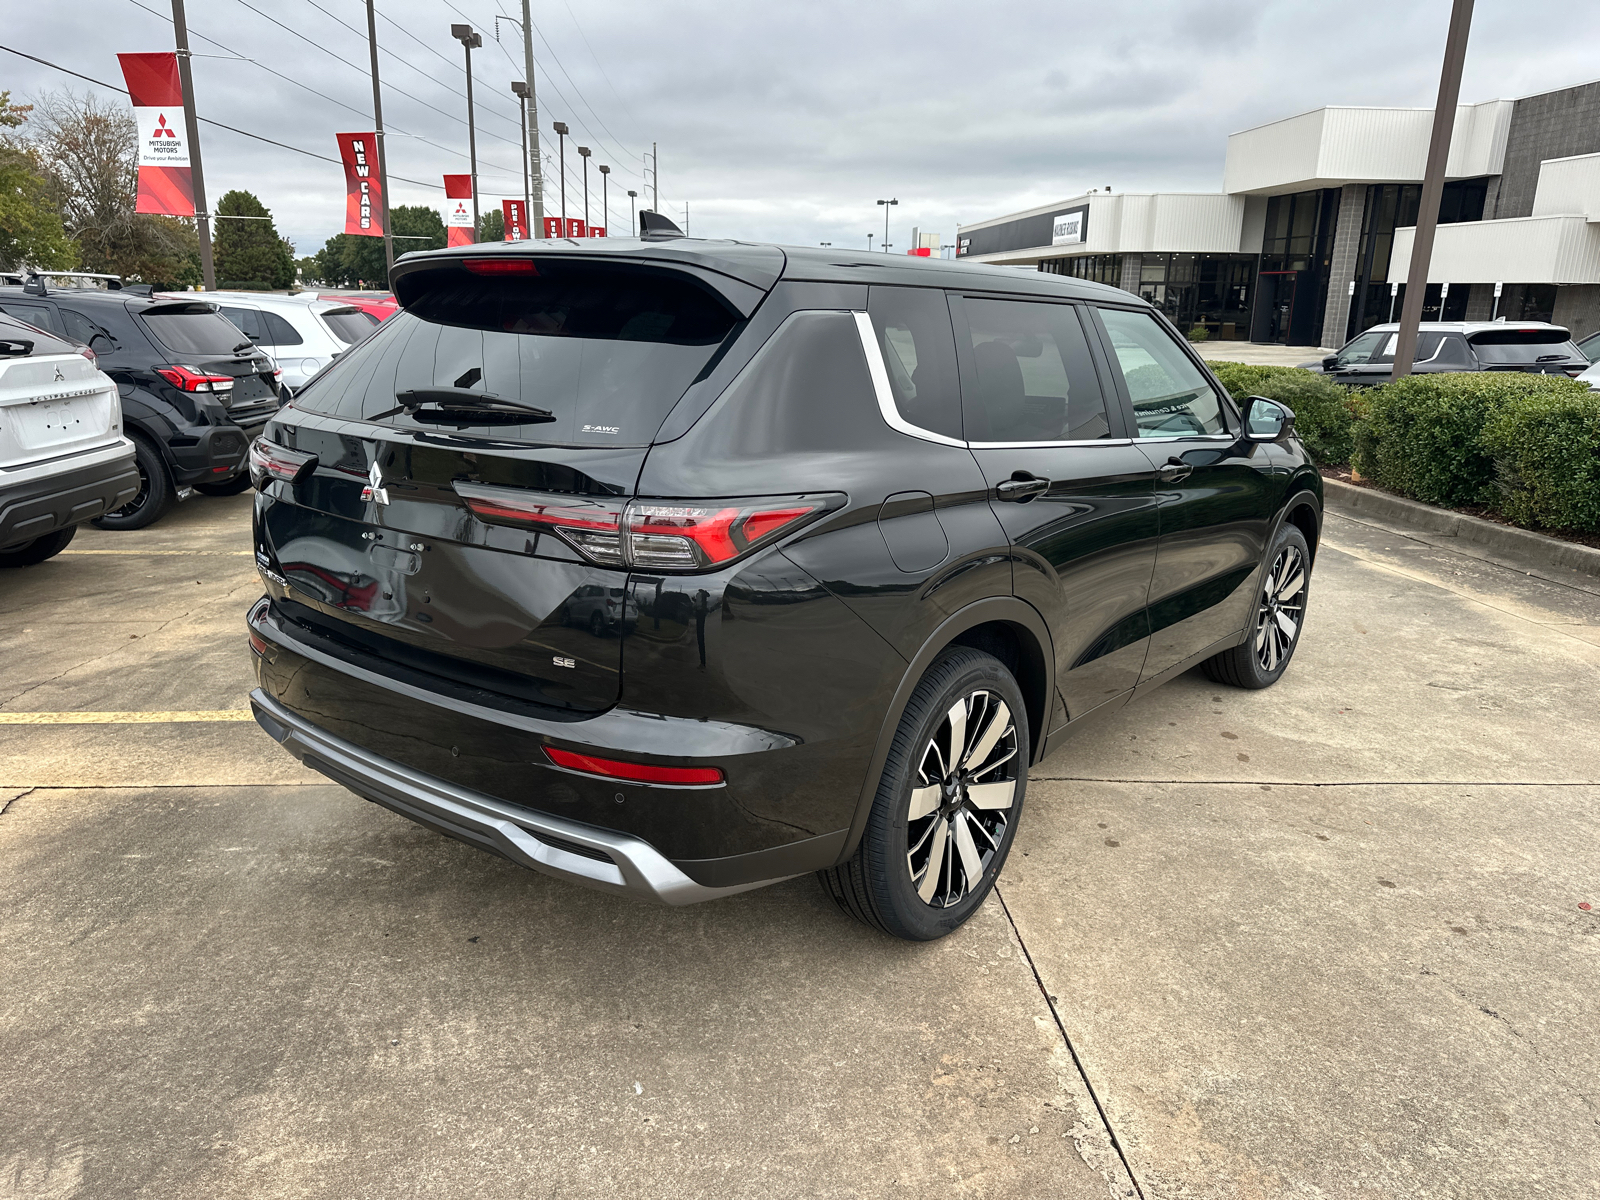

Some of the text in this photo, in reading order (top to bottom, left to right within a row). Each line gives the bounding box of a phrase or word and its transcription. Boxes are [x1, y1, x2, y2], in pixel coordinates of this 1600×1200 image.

[352, 140, 371, 229] NEW CARS
[510, 203, 521, 240] PRE-OW
[582, 424, 620, 433] S-AWC
[552, 655, 576, 669] SE
